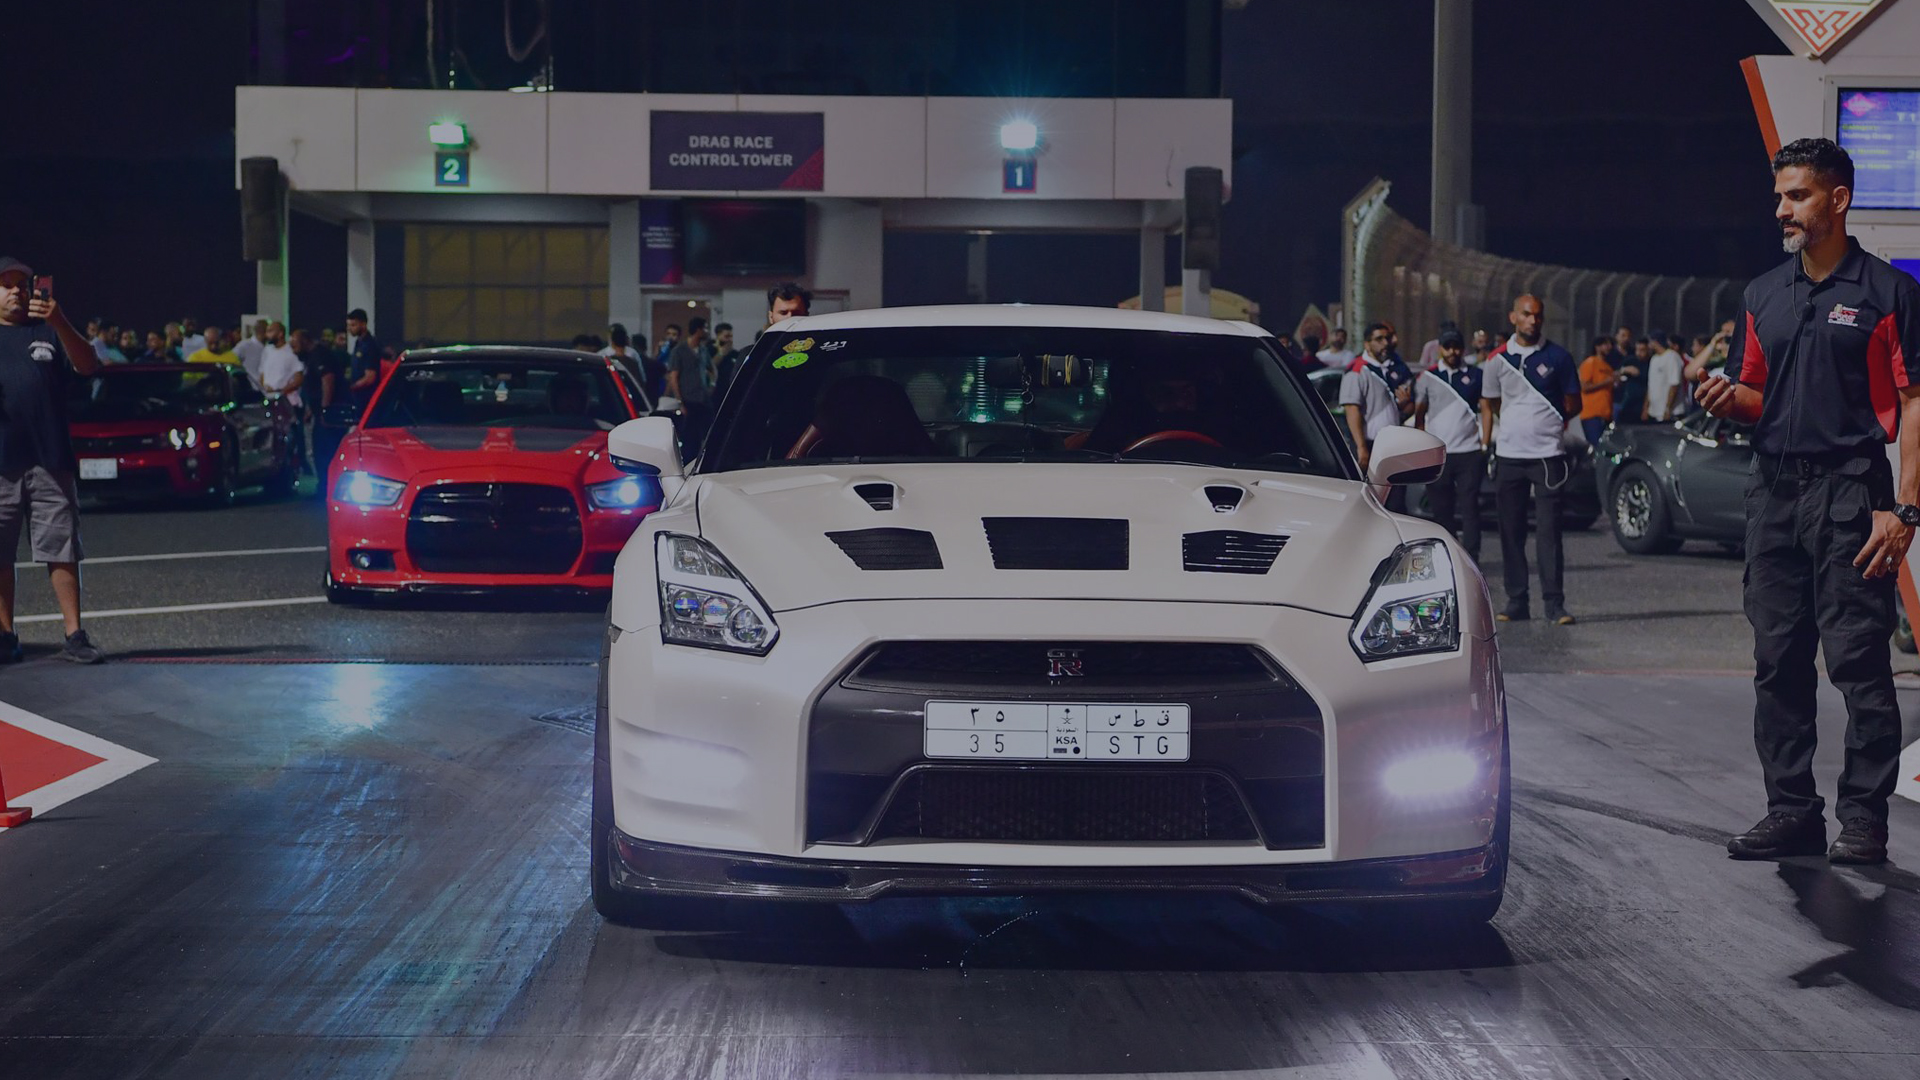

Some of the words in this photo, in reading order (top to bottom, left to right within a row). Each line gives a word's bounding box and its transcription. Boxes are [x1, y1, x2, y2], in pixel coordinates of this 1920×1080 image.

[689, 136, 730, 149] DRAG
[734, 136, 774, 149] RACE
[669, 154, 739, 166] CONTROL
[742, 154, 793, 167] TOWER
[443, 157, 460, 181] 2
[1015, 166, 1023, 187] 1
[1056, 736, 1078, 745] KSA
